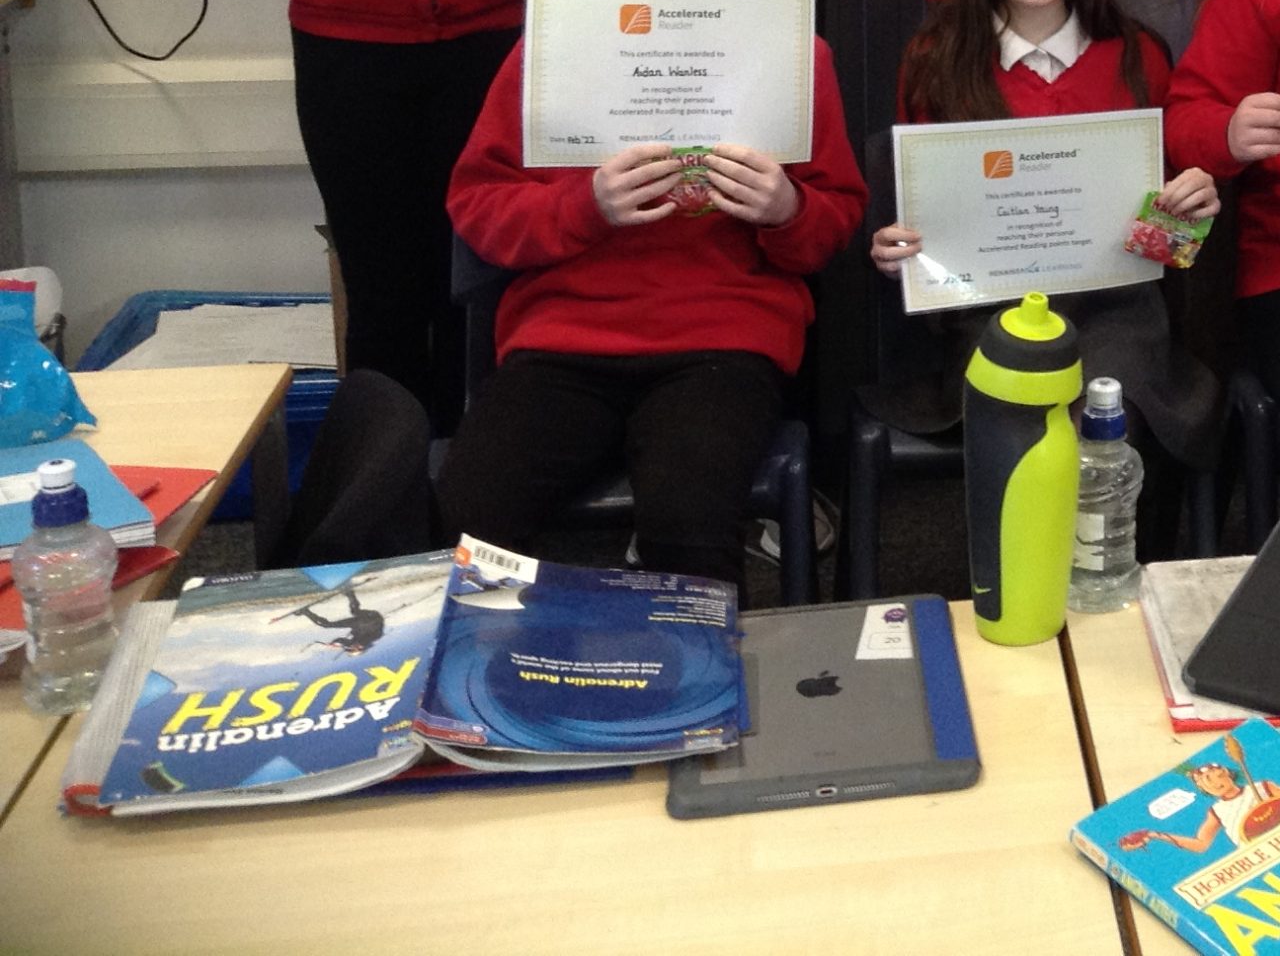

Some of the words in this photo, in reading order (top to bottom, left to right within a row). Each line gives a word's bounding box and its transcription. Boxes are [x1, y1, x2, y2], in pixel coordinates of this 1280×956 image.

[658, 9, 722, 19] Accelerated
[658, 20, 694, 30] Reader
[620, 50, 635, 58] This
[636, 50, 674, 58] certificate
[683, 50, 716, 58] awarded
[651, 86, 693, 94] recognition
[630, 97, 662, 105] reaching
[683, 97, 715, 105] personal
[655, 108, 685, 117] Reading
[686, 108, 709, 116] points
[1019, 149, 1077, 162] Accelerated
[999, 189, 1035, 199] certificate
[1044, 187, 1073, 196] awarded
[1034, 203, 1060, 219] Young
[519, 671, 561, 684] Rush
[564, 676, 648, 689] Adrenalin
[161, 657, 421, 736] RUSH
[157, 696, 400, 755] Adrenalin
[1193, 847, 1271, 896] HORRIBLE
